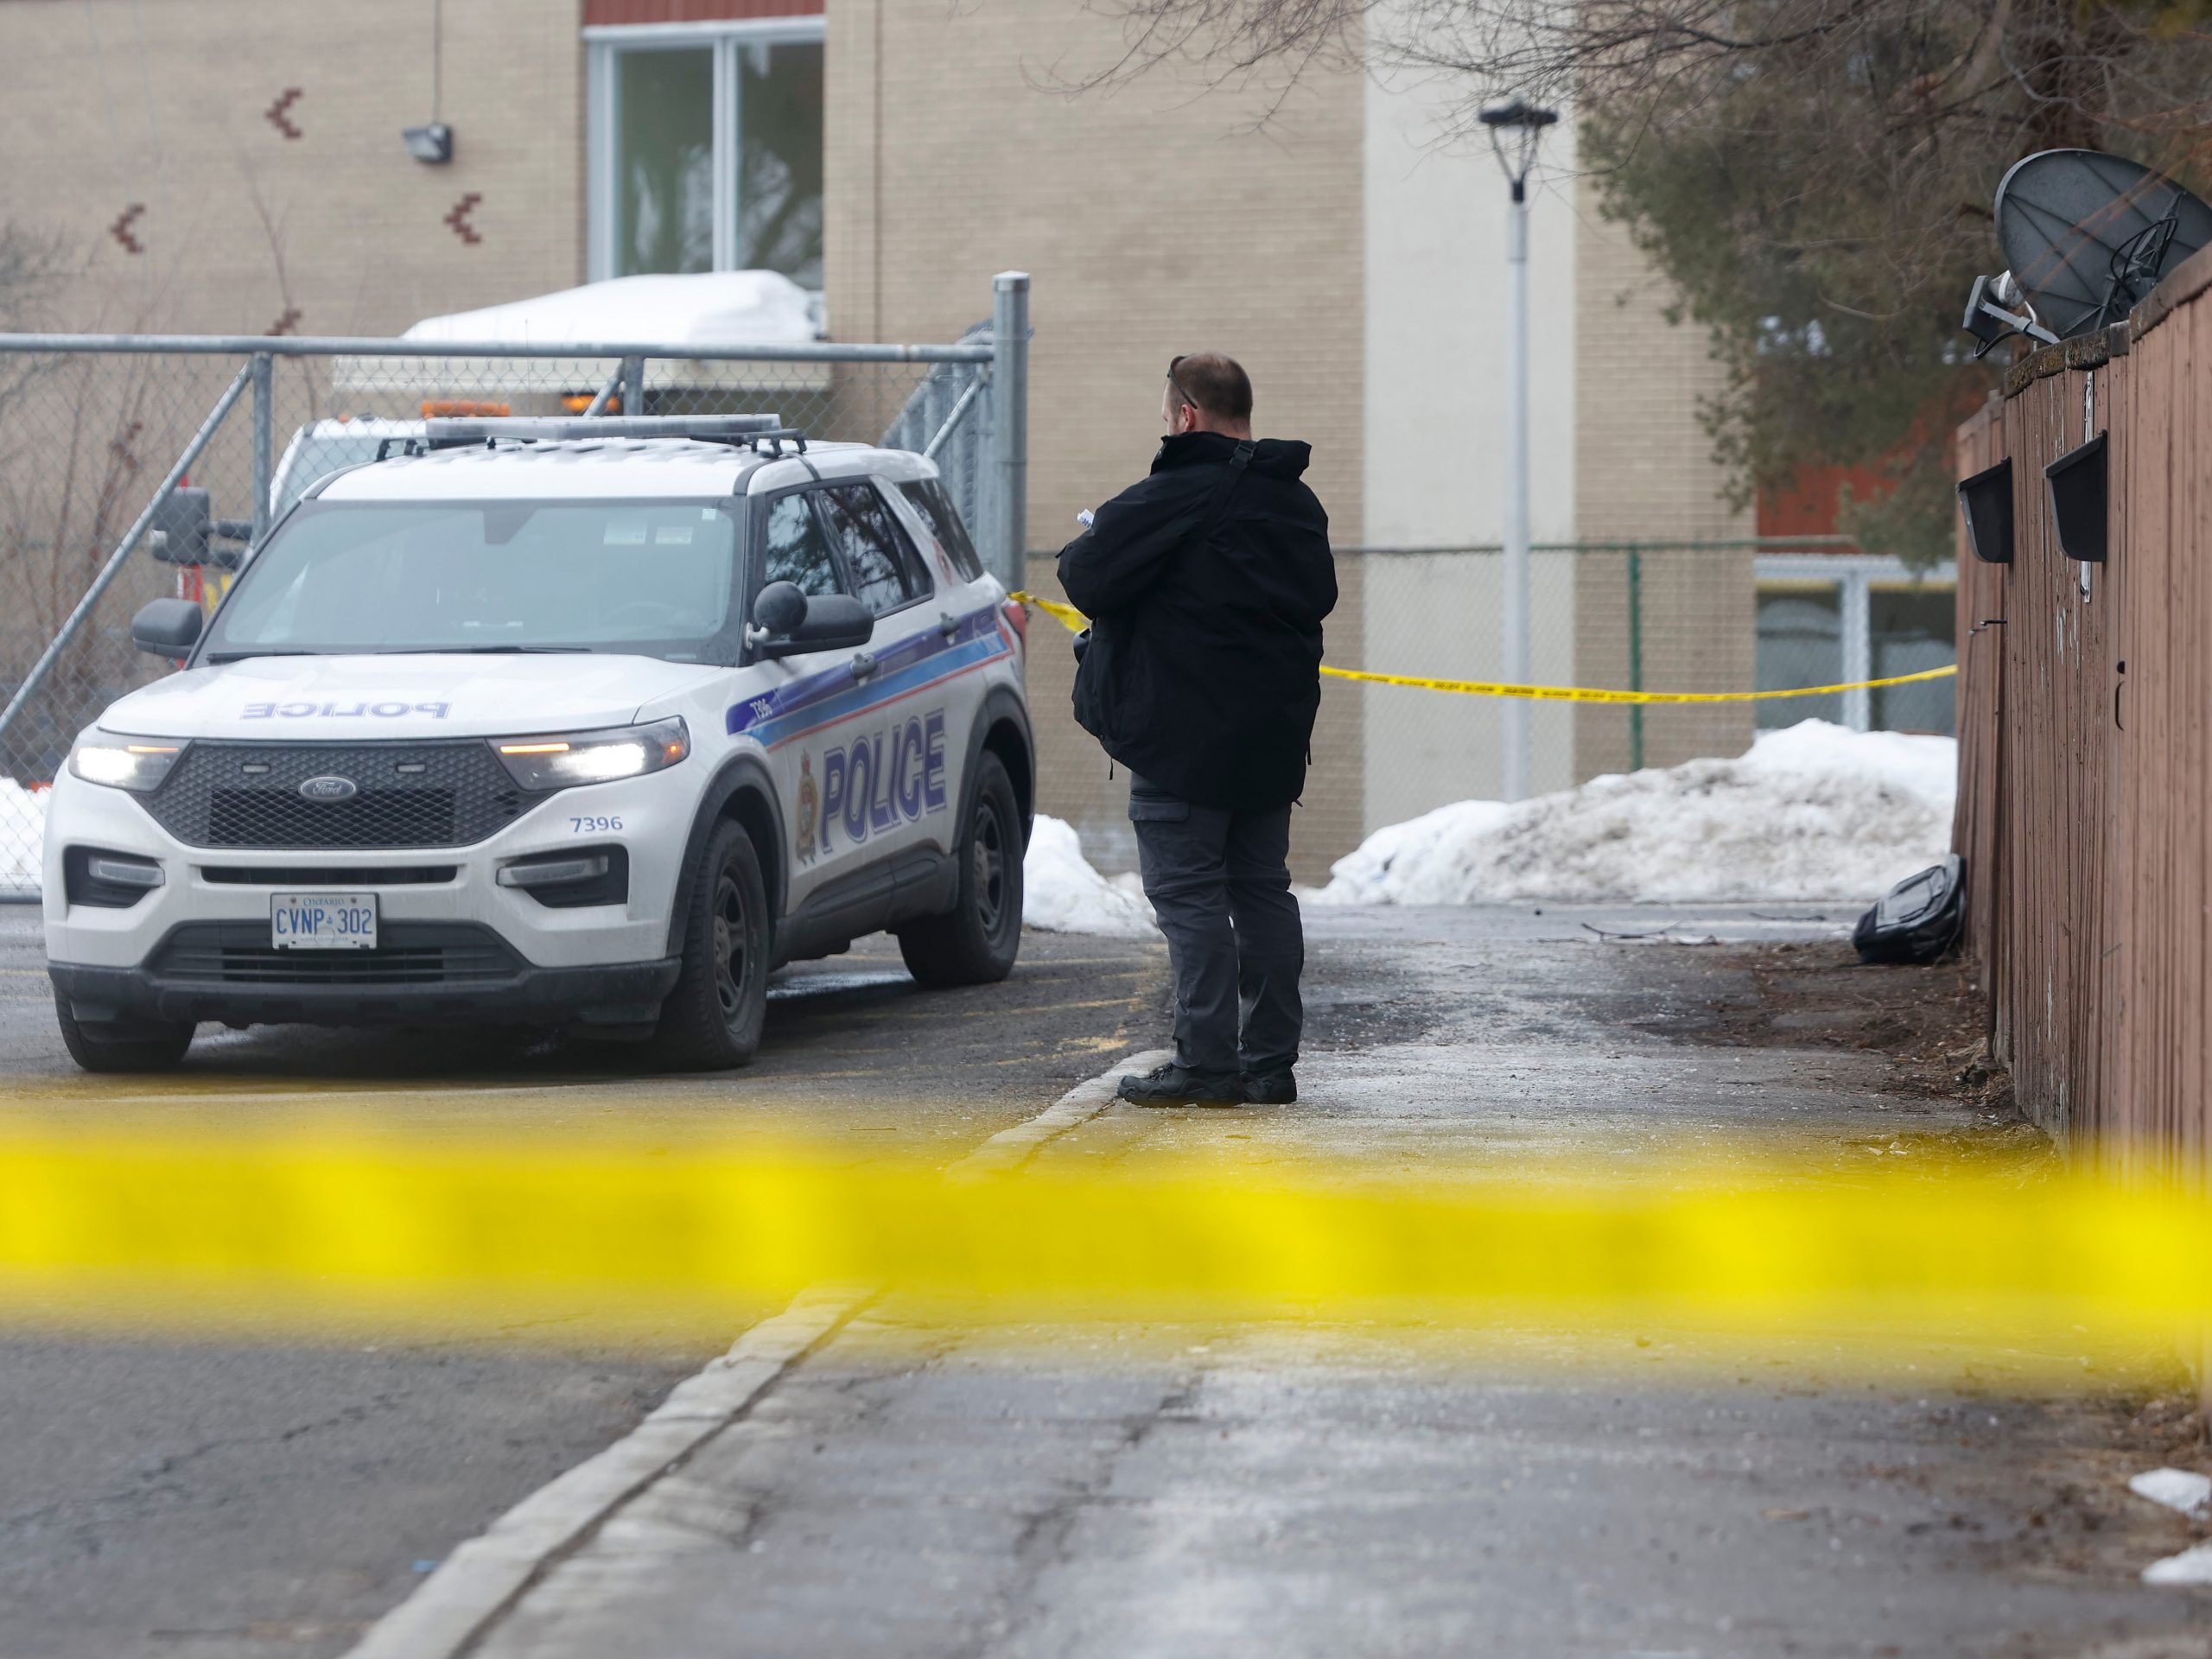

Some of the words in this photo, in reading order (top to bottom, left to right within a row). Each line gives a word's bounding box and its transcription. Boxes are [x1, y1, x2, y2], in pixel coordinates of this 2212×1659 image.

[313, 781, 342, 795] Ford
[820, 707, 947, 855] POLICE
[569, 817, 623, 832] 7396
[302, 898, 345, 906] ONTARIO
[276, 907, 324, 934] CVNP
[338, 907, 372, 934] 302
